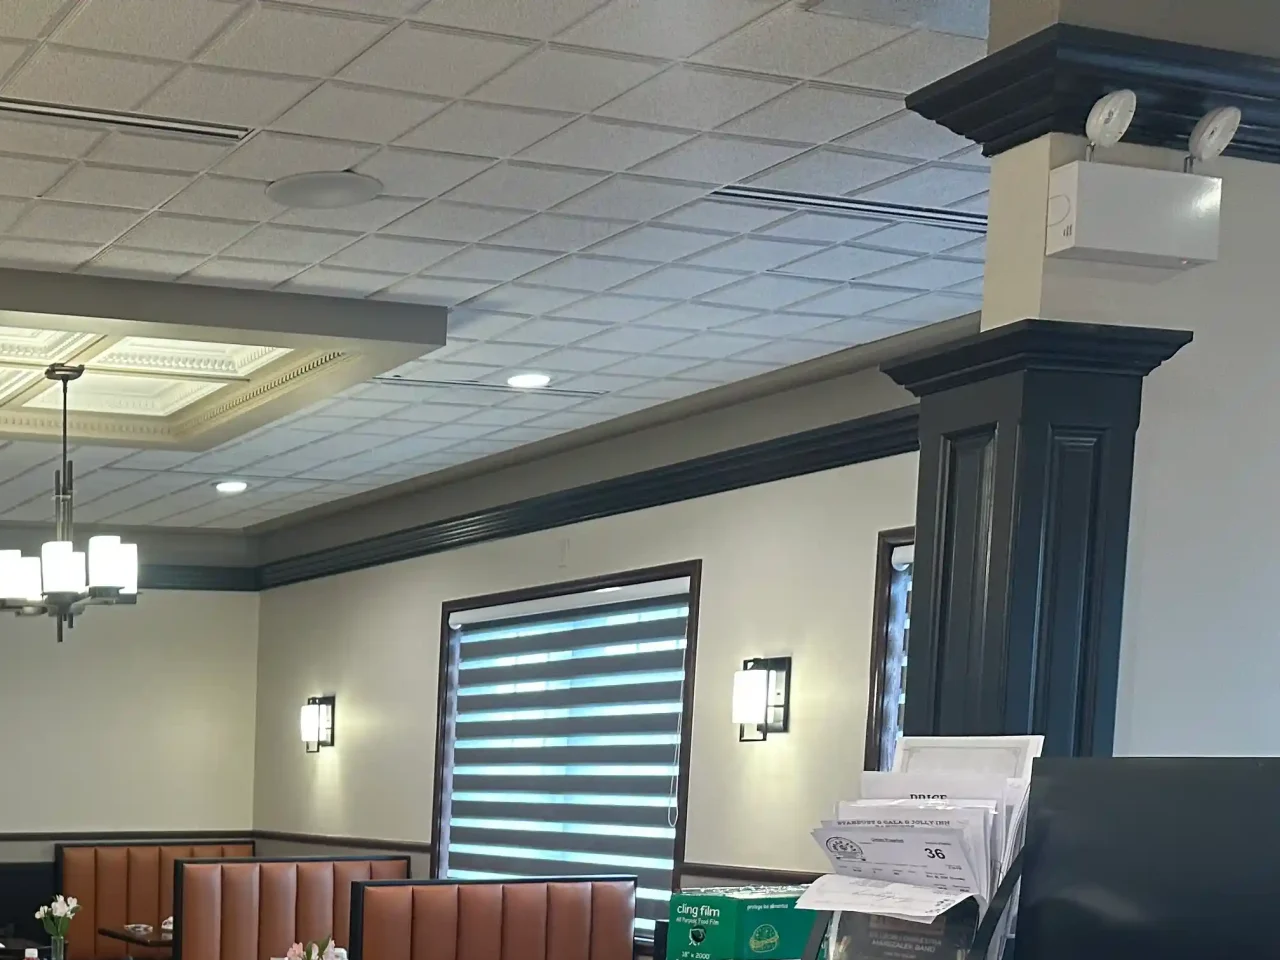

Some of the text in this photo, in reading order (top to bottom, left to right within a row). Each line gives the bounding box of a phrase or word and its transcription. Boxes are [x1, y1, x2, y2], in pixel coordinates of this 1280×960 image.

[925, 848, 946, 859] 36
[677, 903, 720, 917] cling film
